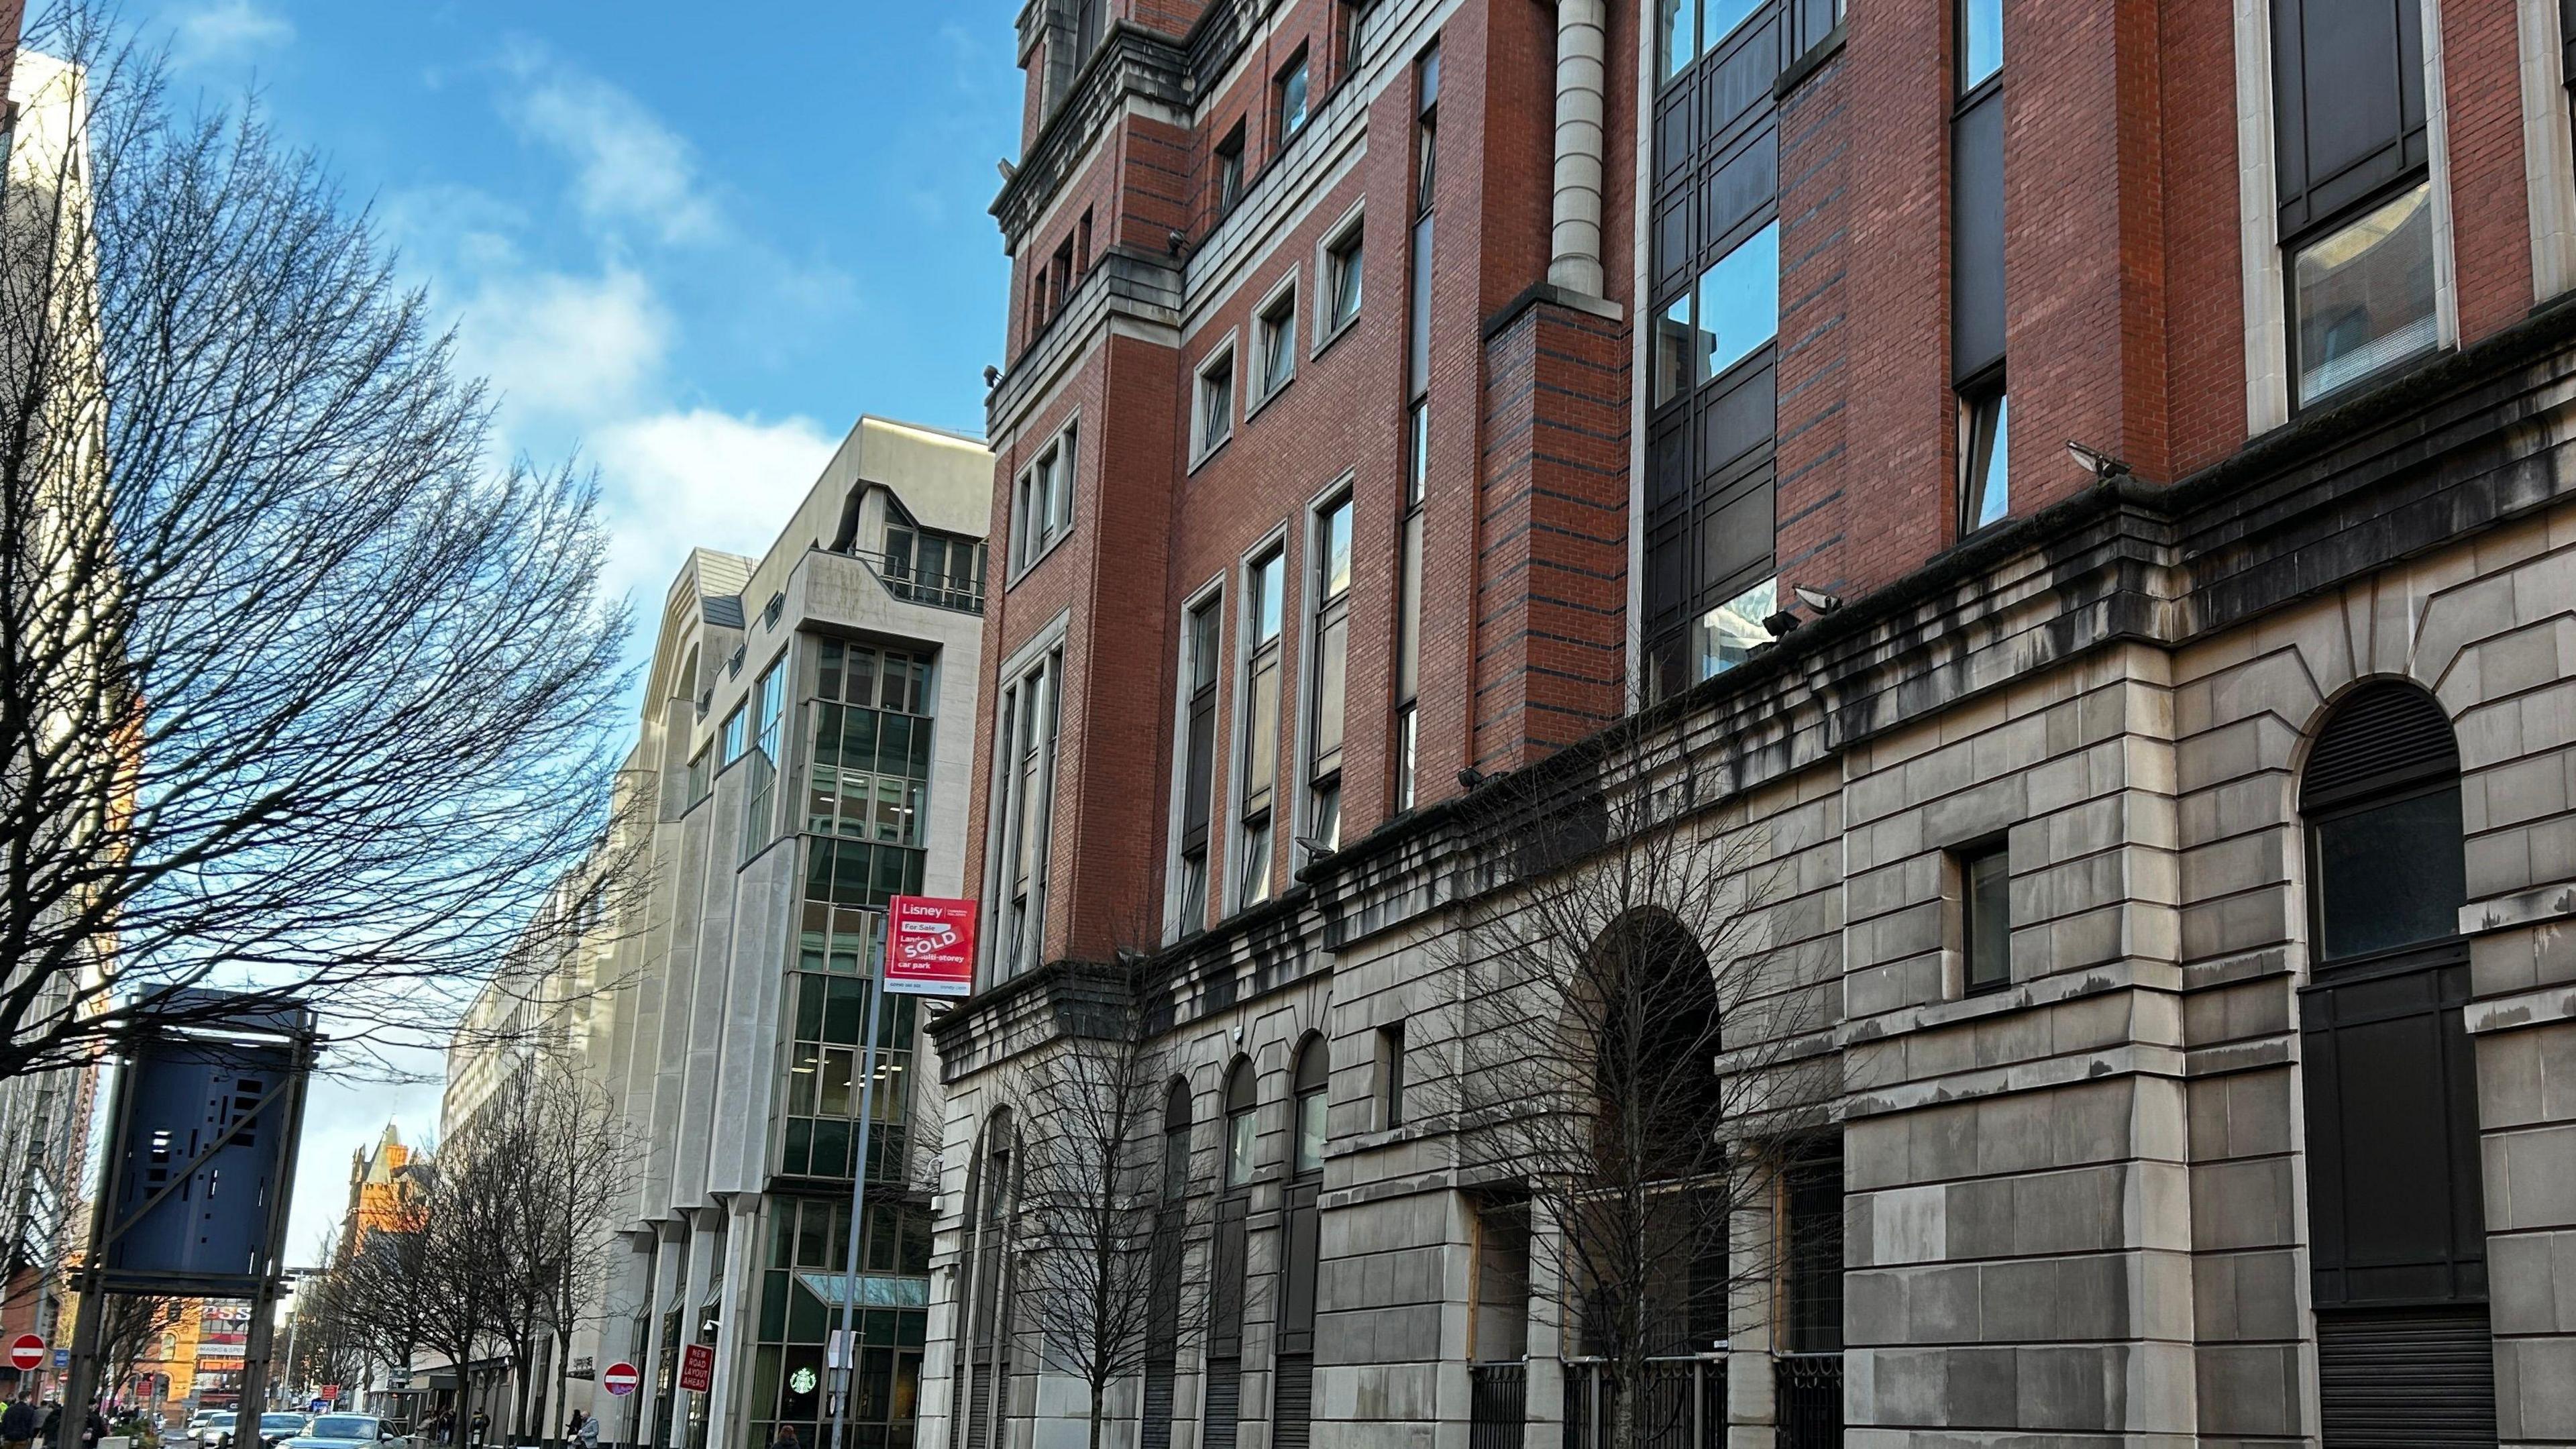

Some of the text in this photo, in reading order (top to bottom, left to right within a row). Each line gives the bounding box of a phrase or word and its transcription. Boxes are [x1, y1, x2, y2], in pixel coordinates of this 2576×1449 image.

[903, 904, 943, 918] Lisney
[904, 931, 957, 958] SOLD
[920, 954, 965, 963] ulti-storey
[912, 961, 931, 969] park
[692, 1349, 706, 1358] NEW
[689, 1358, 706, 1368] ROAD
[684, 1367, 708, 1378] LAYOUT
[683, 1377, 705, 1387] AHEAD
